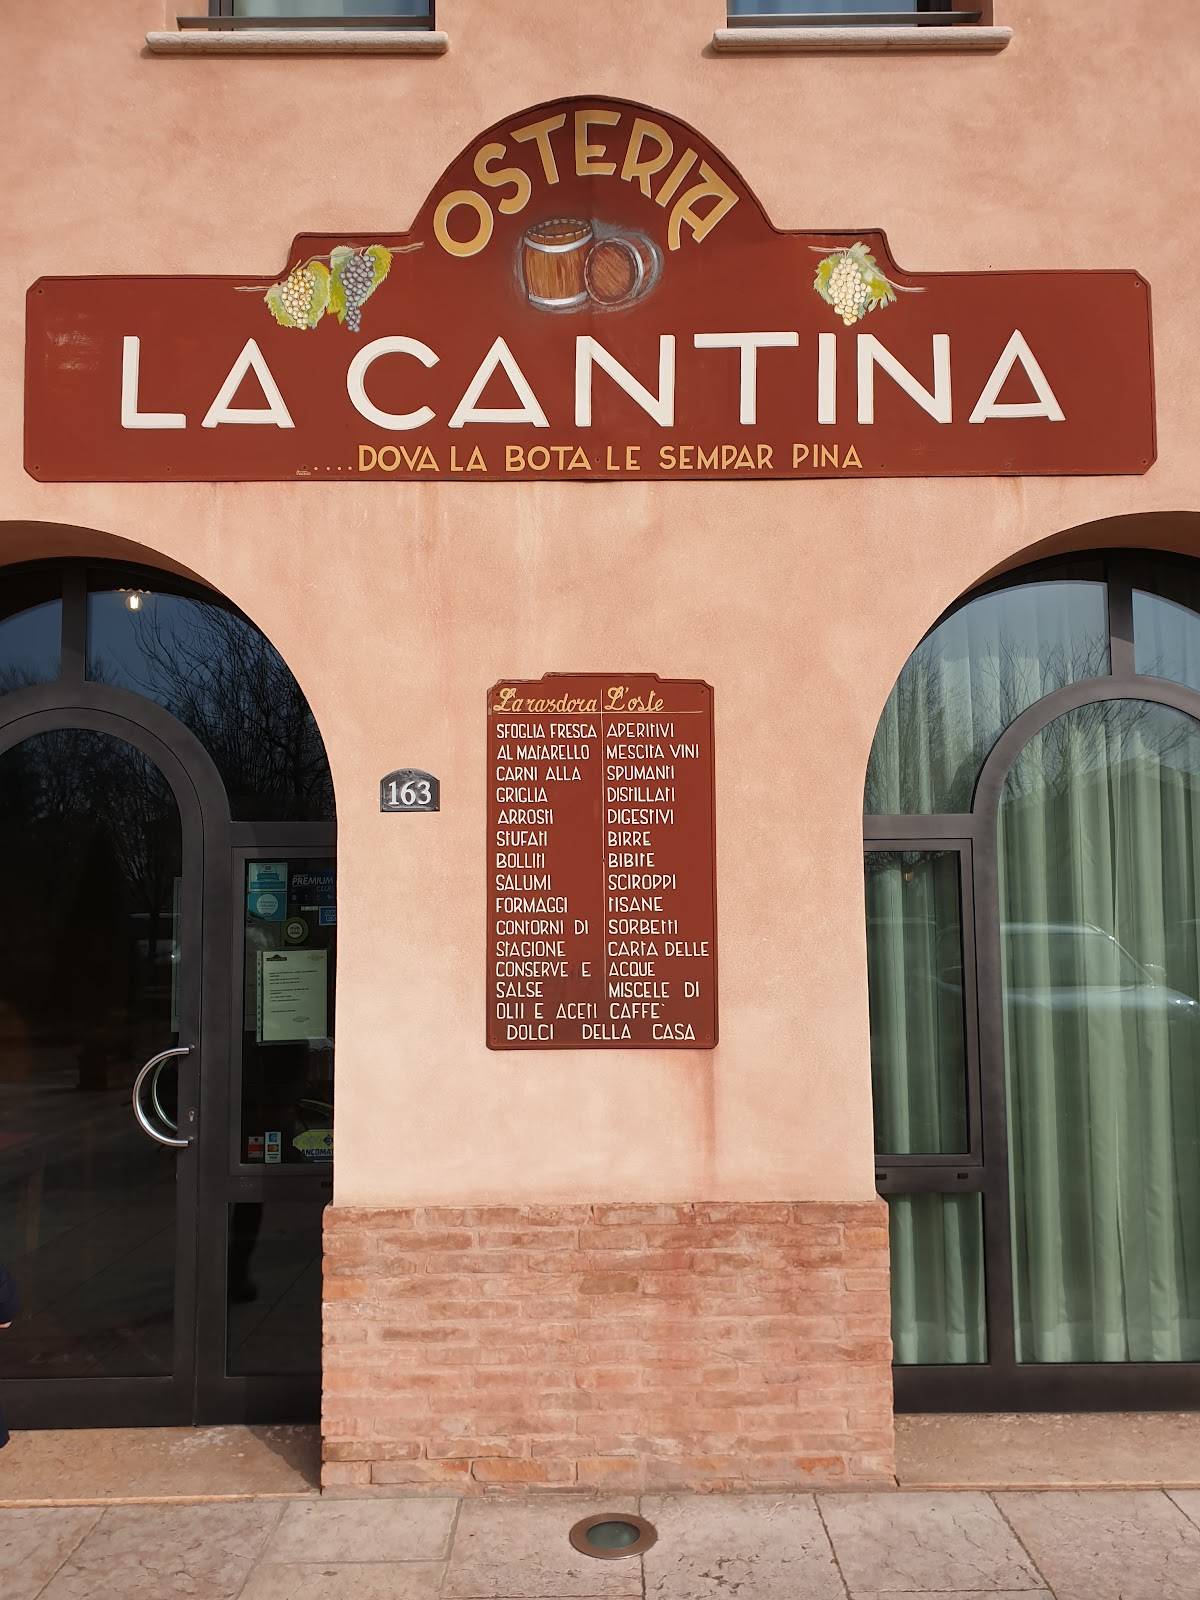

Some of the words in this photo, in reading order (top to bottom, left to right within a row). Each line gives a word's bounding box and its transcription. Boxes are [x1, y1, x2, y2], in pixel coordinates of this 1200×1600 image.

[433, 110, 739, 257] OSTERIA
[121, 336, 295, 430] LA
[347, 329, 1066, 431] CANTINA
[450, 445, 487, 472] LA
[505, 445, 592, 472] BOTA
[606, 445, 641, 471] LE
[659, 444, 774, 470] SEMPAR
[792, 443, 863, 469] PINA
[497, 724, 545, 738] SFOGLIA
[550, 724, 597, 738] FRESCA
[607, 723, 673, 737] APERITIVI
[497, 744, 513, 760] AL
[517, 745, 589, 760] MATARELLO
[607, 744, 664, 759] MESCITA
[670, 744, 698, 758] VINI
[496, 766, 537, 781] CARNI
[546, 766, 581, 780] ALLA
[607, 765, 674, 781] SPUMANTI
[388, 780, 431, 805] 163
[497, 787, 548, 803] GRIGLIA
[607, 787, 674, 802] DISTILLATI
[498, 809, 553, 824] ARROSTI
[608, 809, 673, 824] DIGESTIVI
[497, 831, 547, 846] STUFATI
[608, 831, 651, 846] BIRRE
[497, 853, 544, 868] BOLLITI
[609, 853, 655, 867] BIBITE
[496, 874, 551, 890] SALUMI
[609, 874, 675, 890] SCIROPPI
[496, 897, 567, 913] FORMAGGI
[609, 897, 663, 912] TISANE
[496, 920, 563, 935] CONTORNI
[575, 920, 588, 934] DI
[609, 919, 677, 934] SORBETTI
[496, 941, 565, 957] STAGIONE
[608, 941, 658, 956] CARTA
[665, 942, 709, 956] DELLE
[496, 962, 568, 977] CONSERVE
[582, 962, 591, 977] E
[609, 962, 655, 976] ACQUE
[496, 982, 543, 998] SALSE
[609, 982, 669, 998] MISCELE
[685, 981, 699, 997] DI
[497, 1003, 523, 1019] OLII
[535, 1003, 543, 1019] E
[556, 1003, 597, 1019] ACETI
[507, 1024, 553, 1040] DOLCI
[583, 1024, 631, 1040] DELLA
[653, 1024, 695, 1040] CASA
